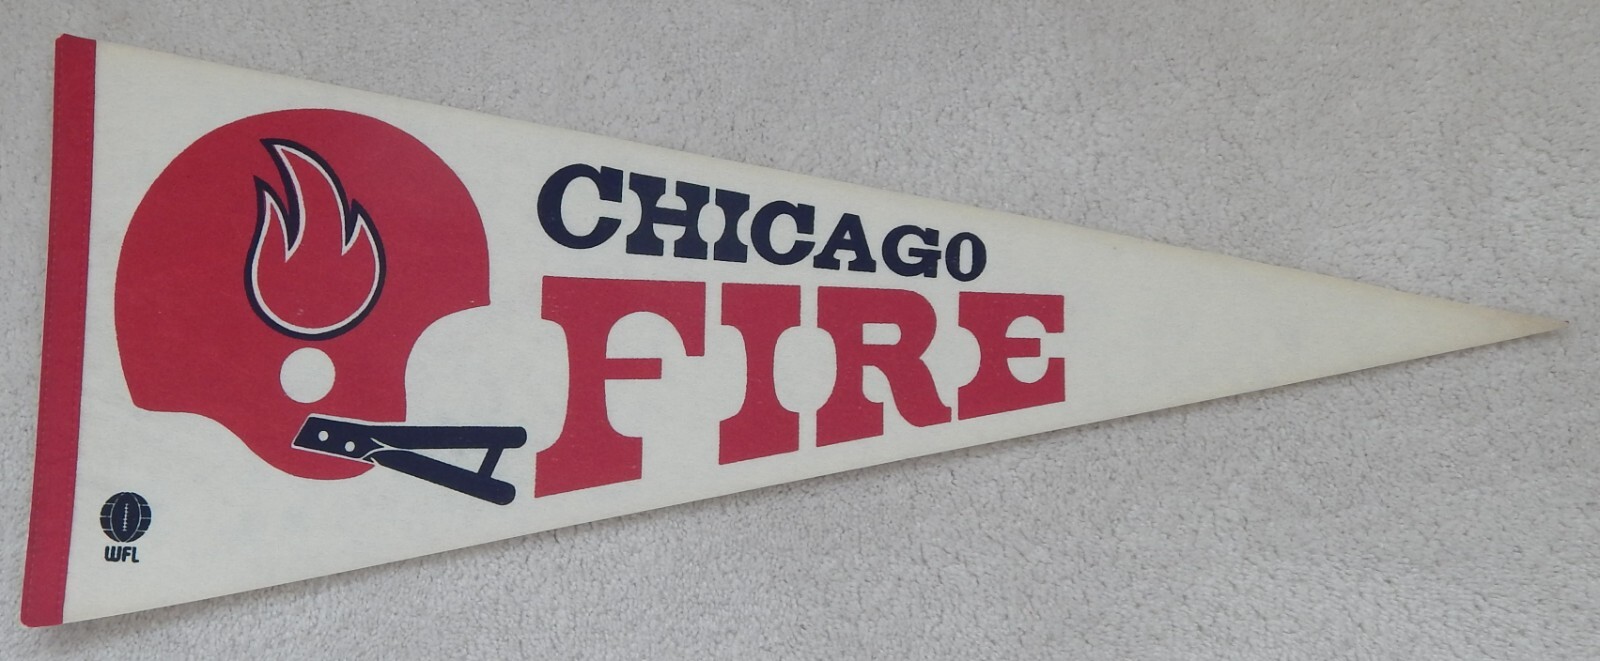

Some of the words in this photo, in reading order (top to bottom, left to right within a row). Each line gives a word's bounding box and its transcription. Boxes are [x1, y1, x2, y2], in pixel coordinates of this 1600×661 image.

[537, 163, 987, 283] CHICAGO
[534, 276, 1065, 498] FIRE
[104, 545, 140, 563] WFL
